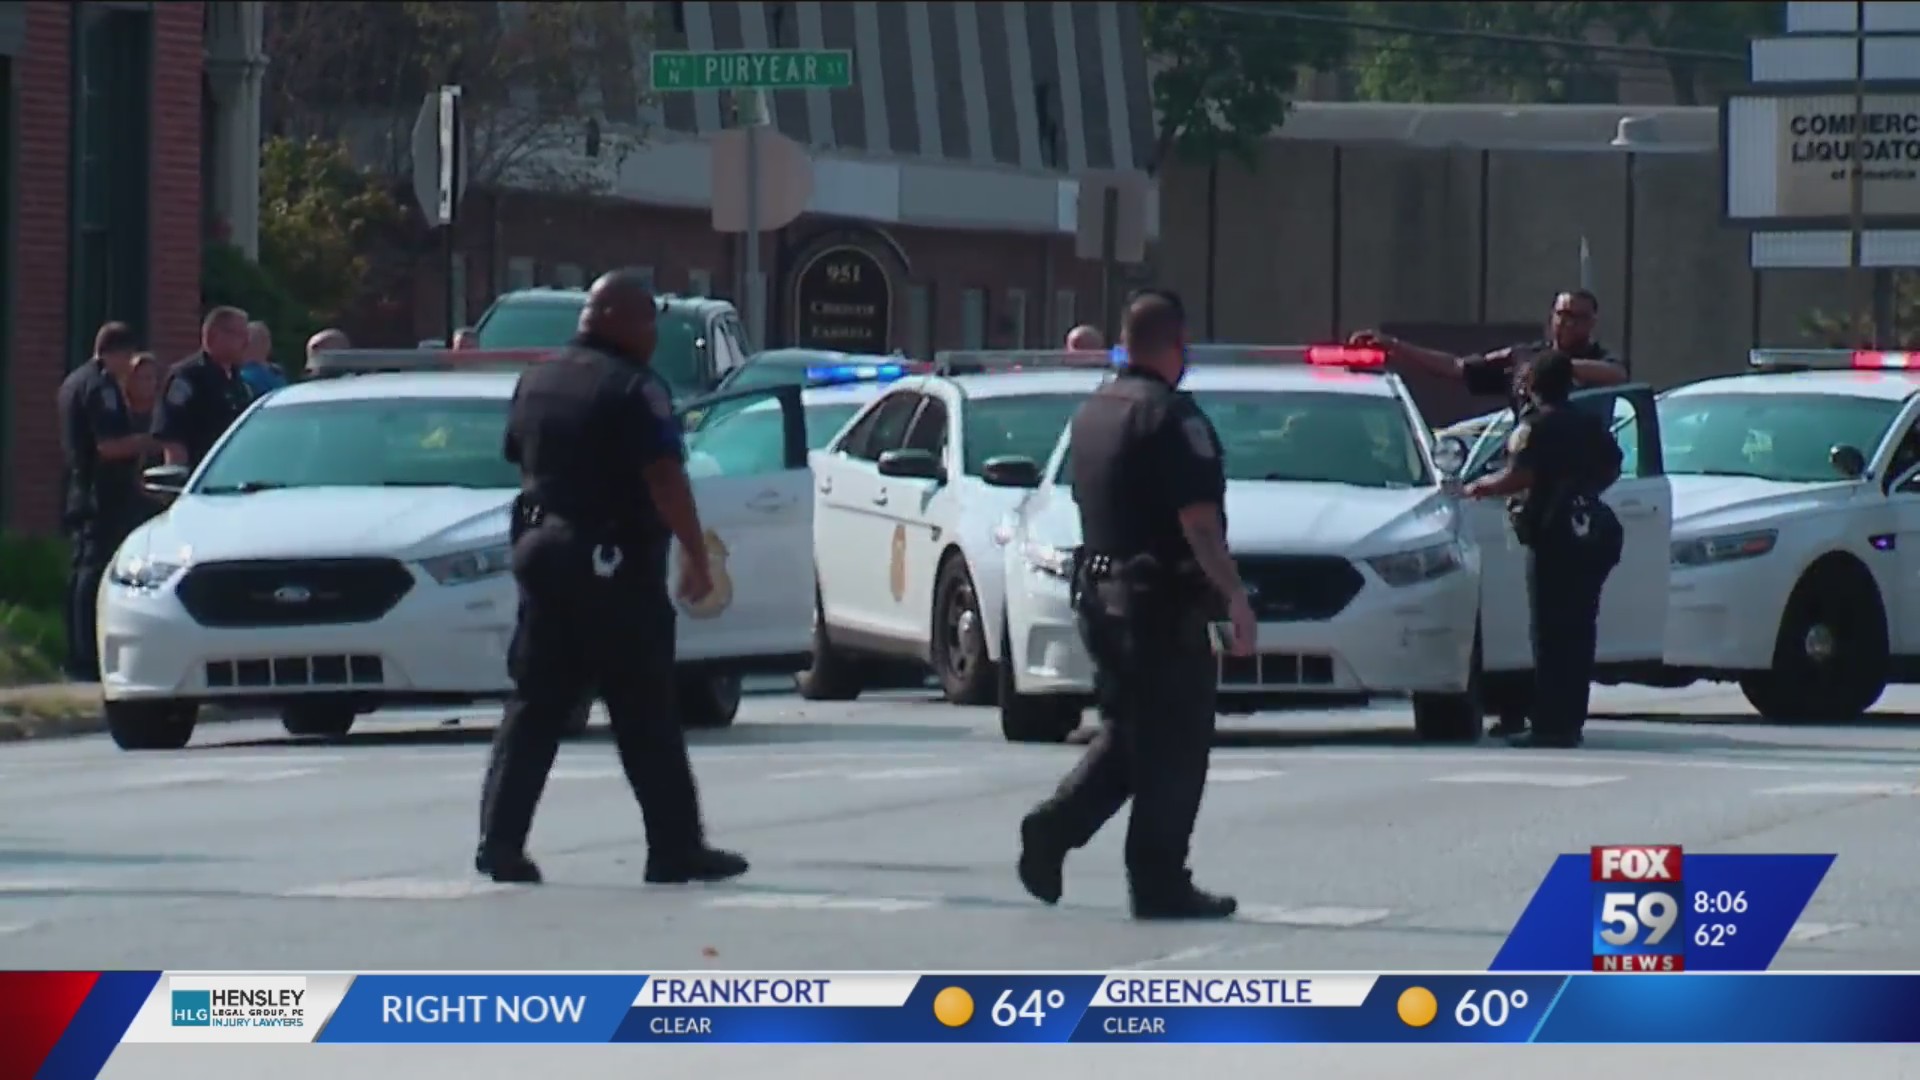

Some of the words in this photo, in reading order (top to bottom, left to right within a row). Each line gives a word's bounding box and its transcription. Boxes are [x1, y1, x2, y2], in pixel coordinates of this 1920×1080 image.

[669, 70, 680, 84] N
[705, 55, 817, 84] PURYEAR
[1831, 169, 1846, 180] of
[826, 263, 860, 281] 951
